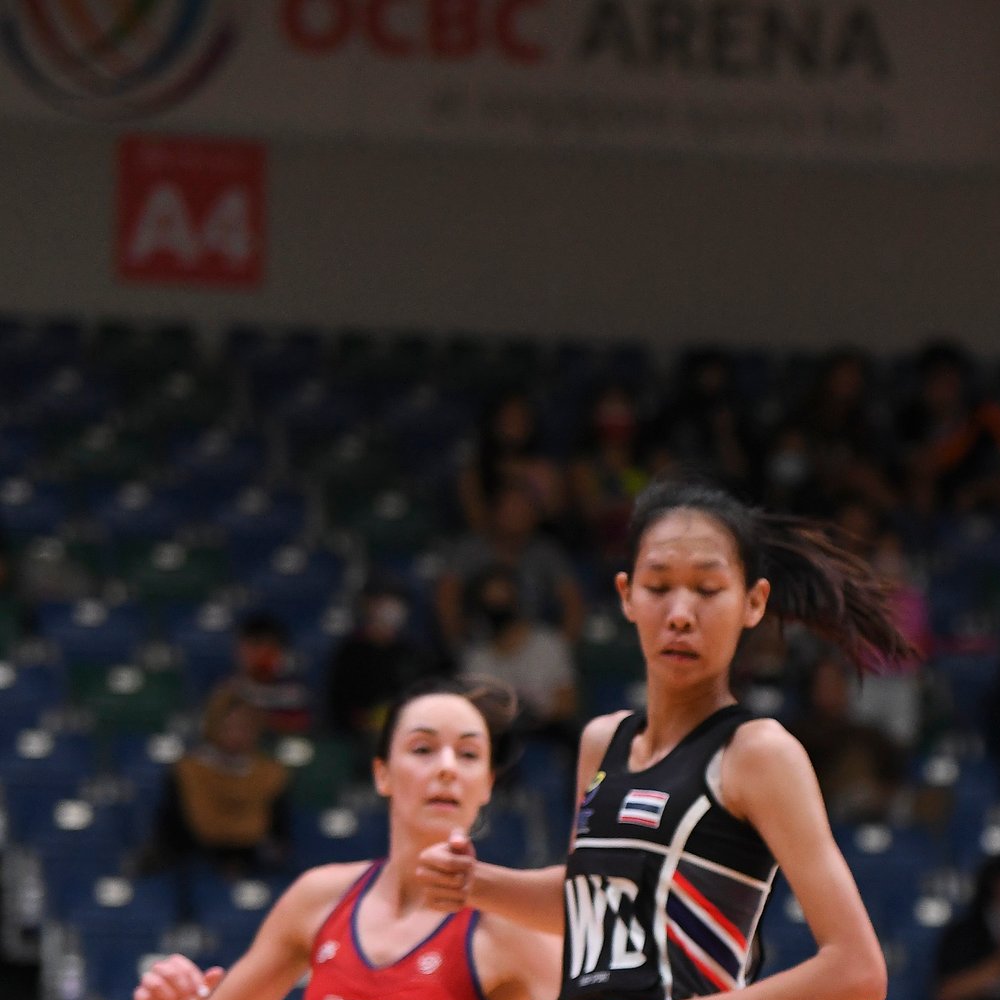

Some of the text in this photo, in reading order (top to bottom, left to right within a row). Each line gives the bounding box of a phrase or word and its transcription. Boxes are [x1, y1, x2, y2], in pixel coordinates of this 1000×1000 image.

[281, 0, 892, 83] OCBC ARENA
[129, 183, 254, 262] A4
[565, 875, 647, 980] WD
